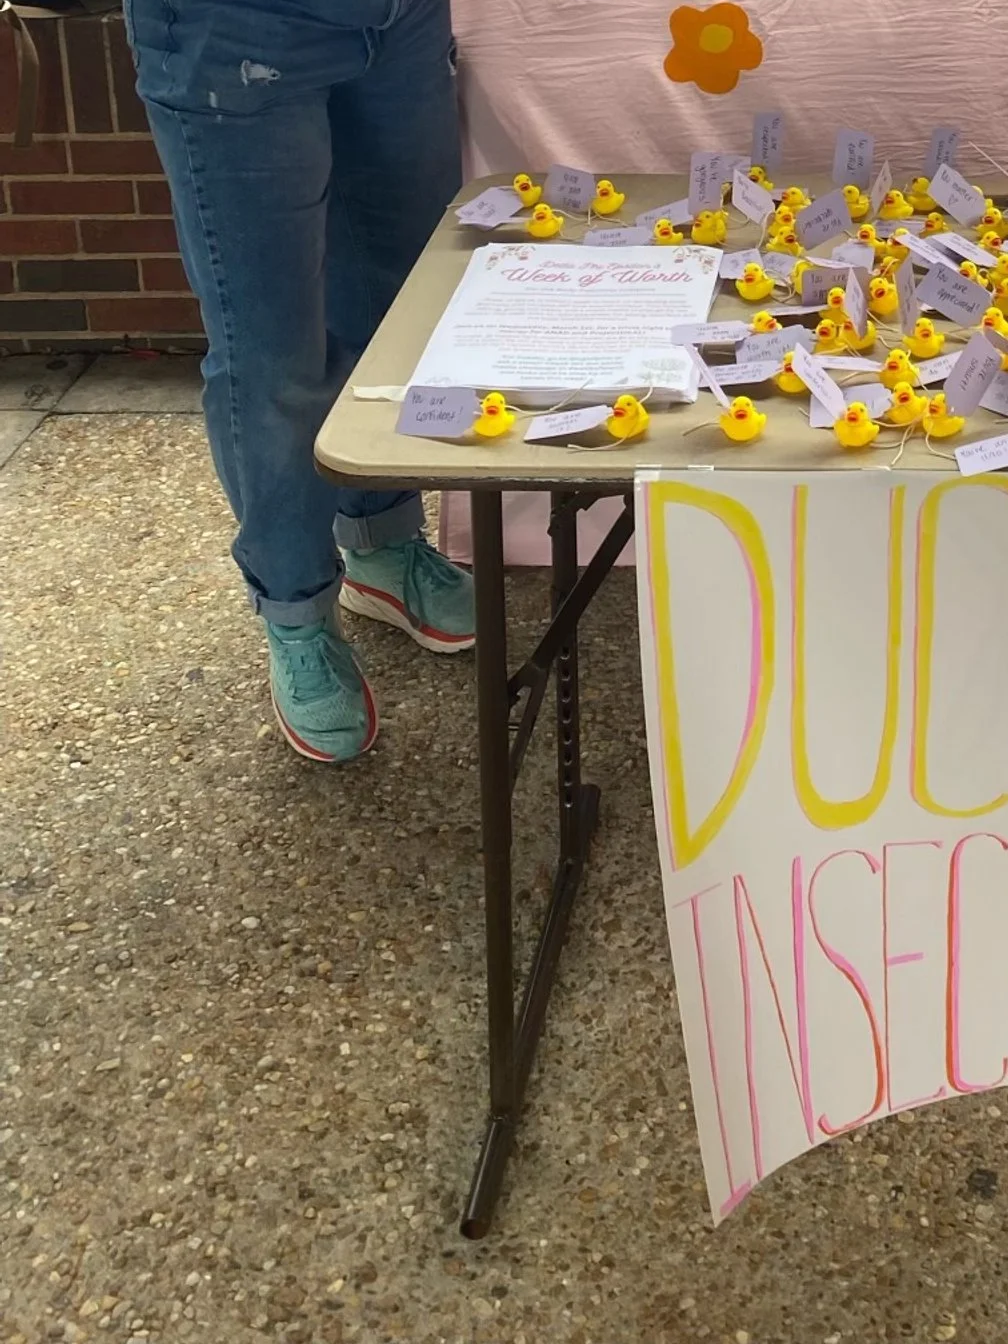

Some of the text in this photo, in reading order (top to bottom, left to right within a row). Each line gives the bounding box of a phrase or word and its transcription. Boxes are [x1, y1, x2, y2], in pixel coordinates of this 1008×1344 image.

[501, 268, 693, 287] Week of Worth
